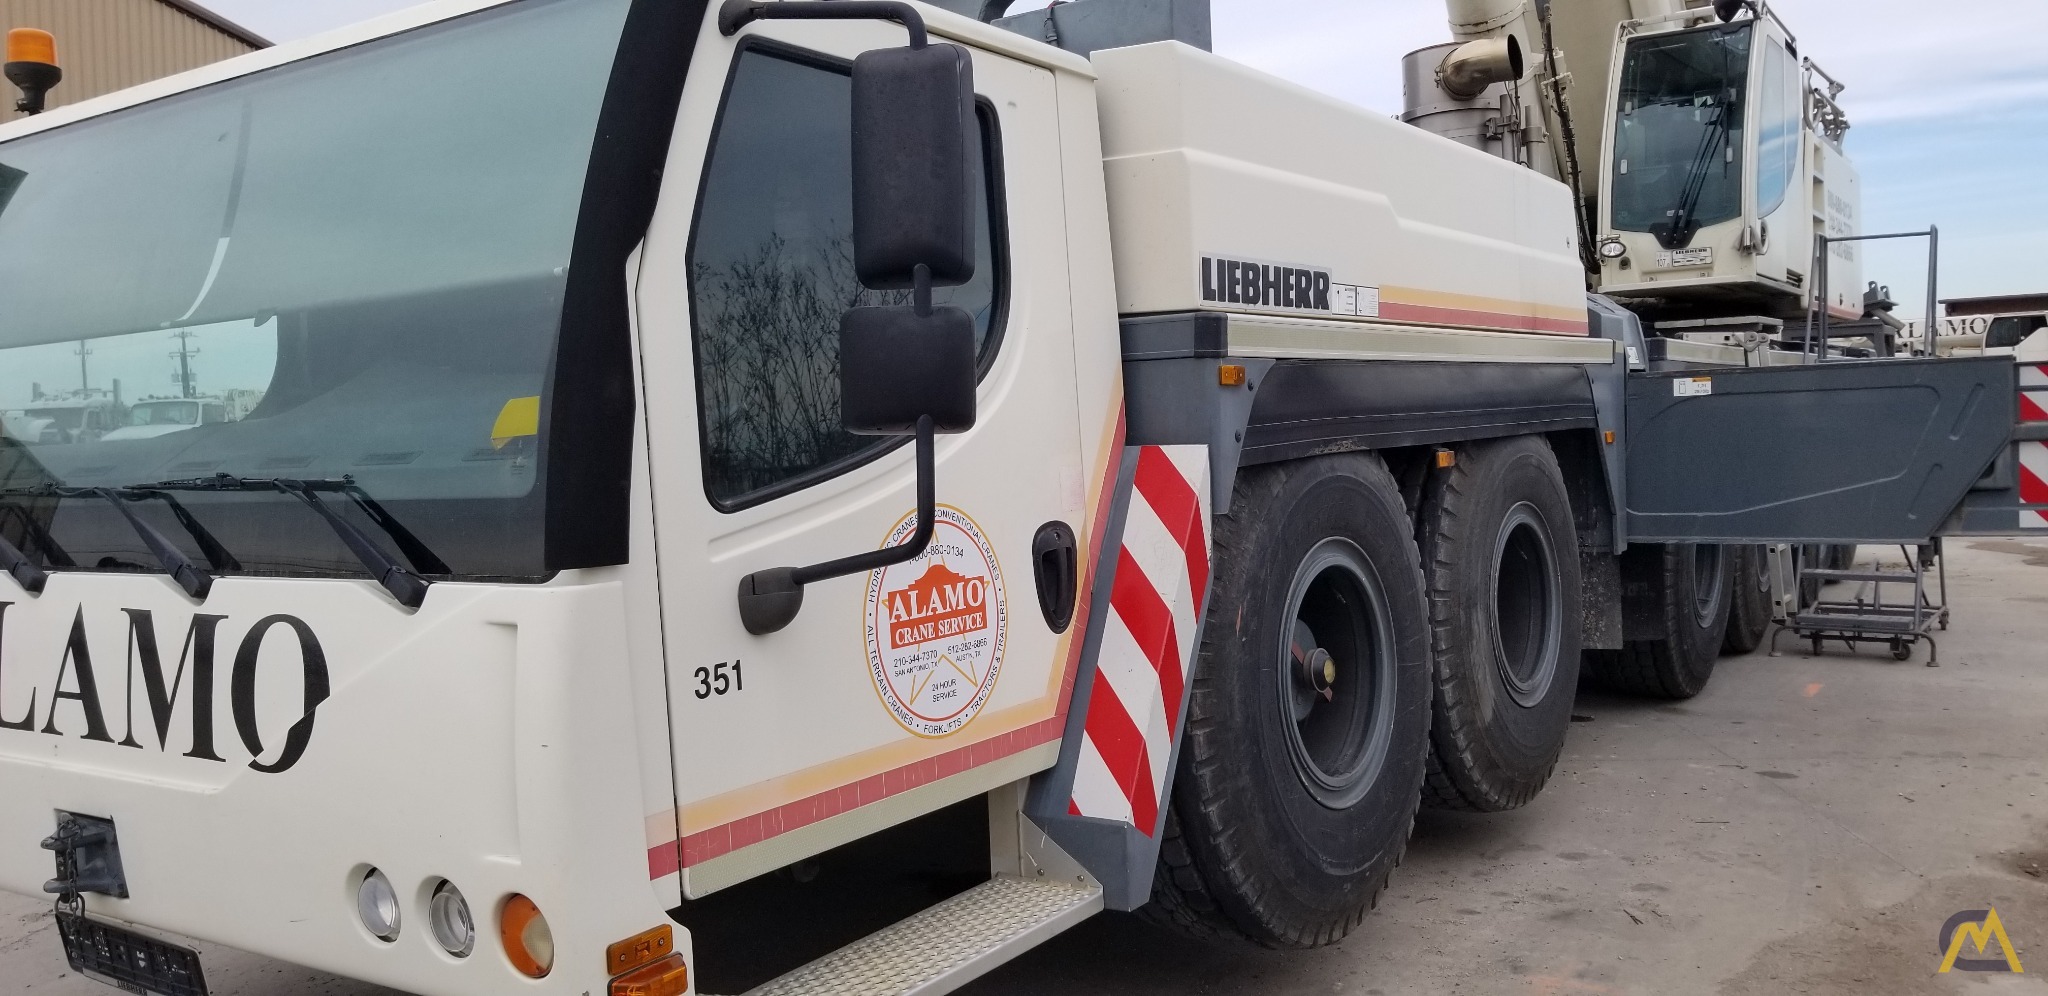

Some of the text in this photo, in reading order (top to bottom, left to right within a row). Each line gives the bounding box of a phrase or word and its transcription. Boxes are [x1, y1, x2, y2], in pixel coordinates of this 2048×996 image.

[1202, 256, 1329, 310] LIEBHERR
[981, 542, 1000, 581] CRANES
[891, 579, 984, 623] ALAMO
[895, 612, 983, 646] CRANE SERVICE
[894, 650, 938, 668] 210-344-7370
[894, 669, 906, 678] SAN
[970, 664, 998, 713] TRACTORS
[997, 600, 1006, 652] TRAILERS
[694, 659, 742, 699] 351
[867, 625, 914, 726] ALL TERRAIN CRANES
[931, 678, 957, 692] 24 HOUR
[932, 689, 958, 703] SERVICE
[923, 717, 962, 734] FORKLIFTS
